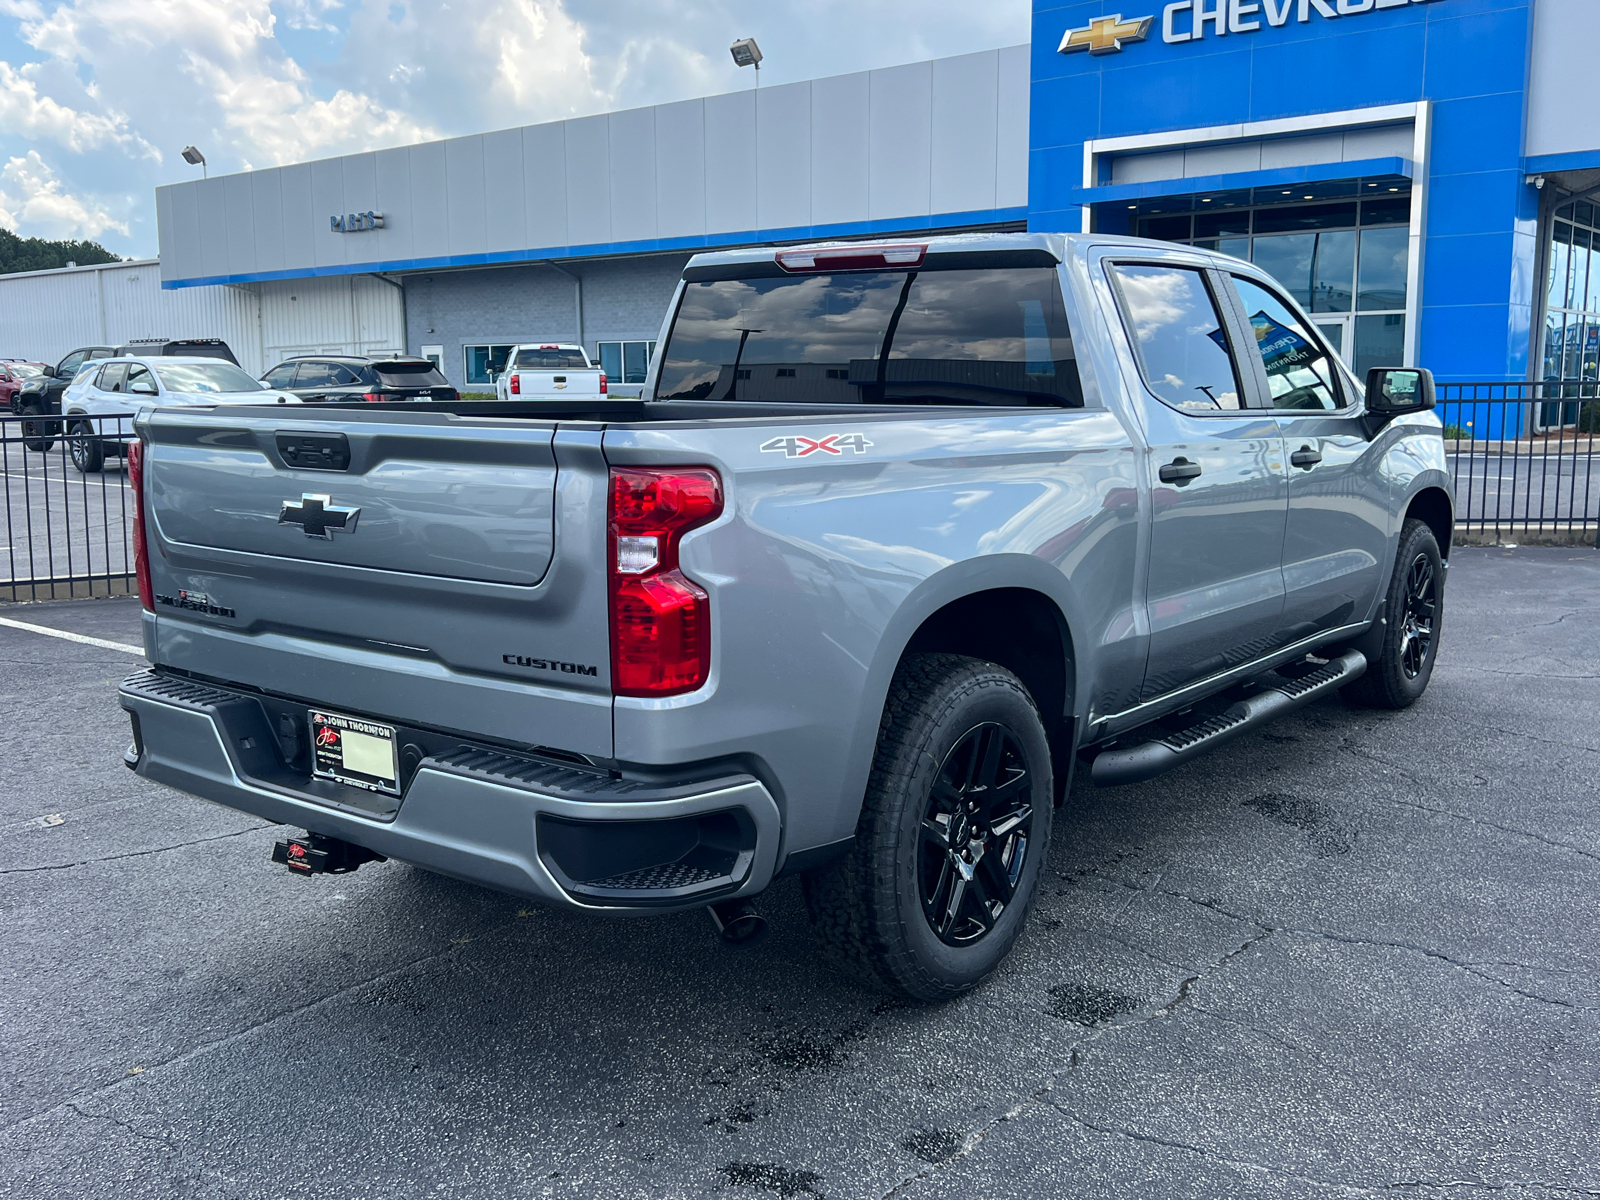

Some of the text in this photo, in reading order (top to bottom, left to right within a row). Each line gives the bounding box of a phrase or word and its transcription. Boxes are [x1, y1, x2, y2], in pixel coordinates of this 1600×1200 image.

[1162, 0, 1447, 43] CHEVR
[330, 210, 376, 232] PARTS
[502, 654, 598, 677] CUSTOM
[328, 716, 348, 728] JOHN
[348, 721, 391, 738] THORNTON
[343, 779, 369, 790] CHEVROLET
